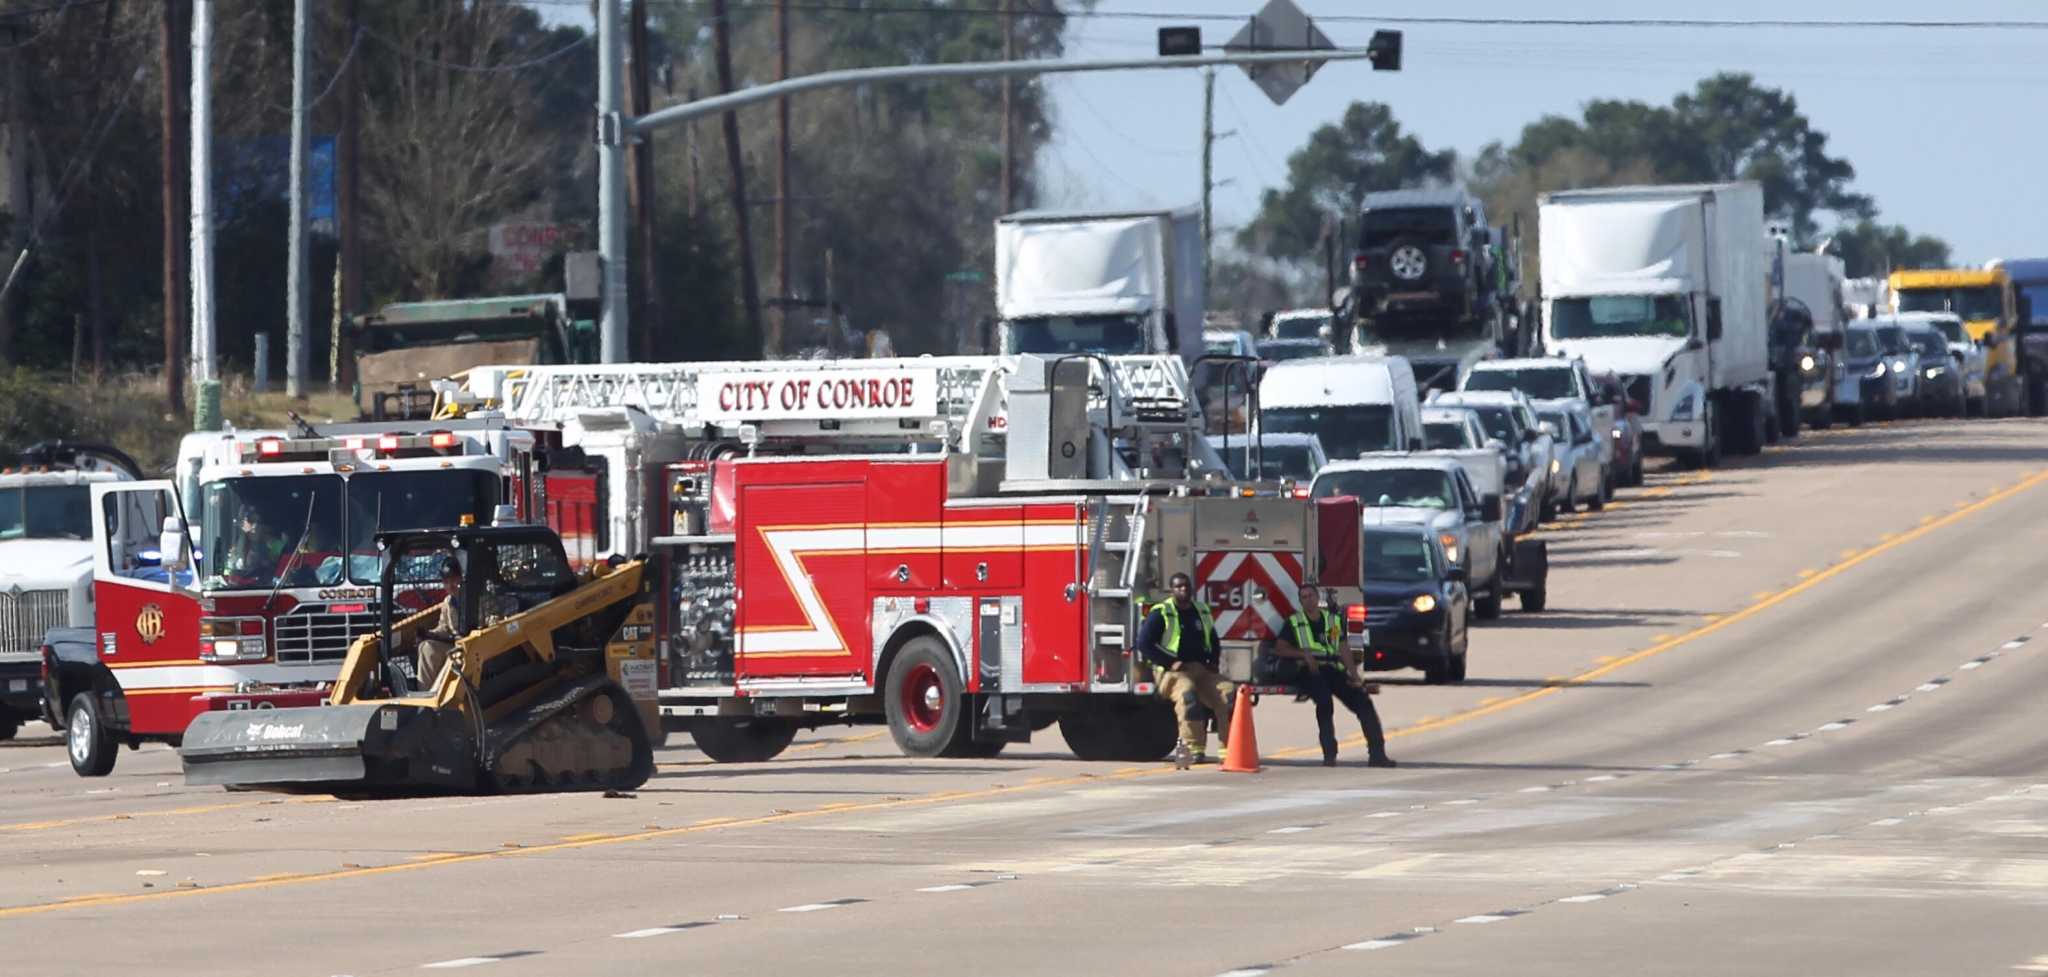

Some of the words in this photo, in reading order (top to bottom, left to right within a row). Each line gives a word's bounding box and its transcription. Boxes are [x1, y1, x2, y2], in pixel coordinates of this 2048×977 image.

[718, 381, 774, 412] CITY
[780, 379, 810, 411] OF
[817, 377, 914, 410] CONROE
[263, 723, 305, 740] Bobcat
